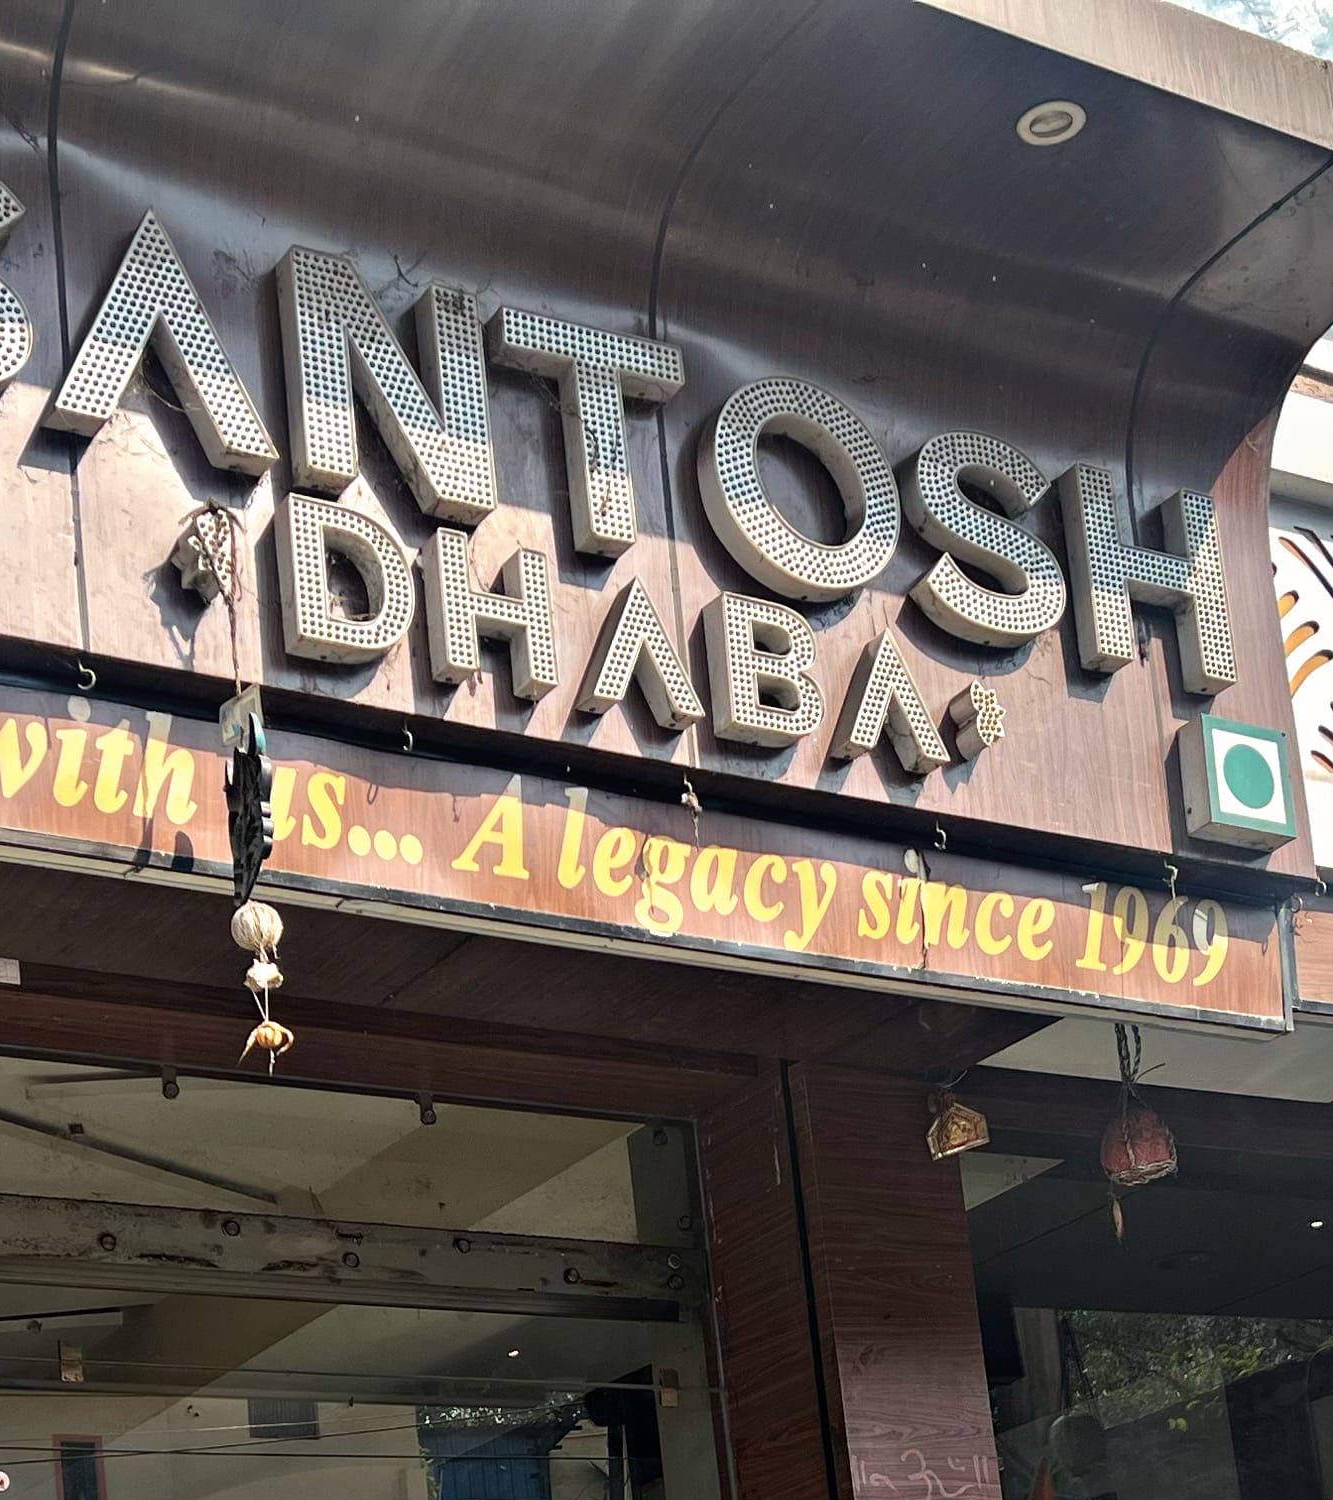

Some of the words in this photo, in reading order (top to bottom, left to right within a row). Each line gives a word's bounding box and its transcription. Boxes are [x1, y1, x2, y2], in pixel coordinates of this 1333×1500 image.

[275, 494, 951, 774] DHABA
[451, 774, 530, 882] A
[556, 786, 838, 953] legacy
[858, 847, 1055, 961] since
[1074, 881, 1230, 988] 1969
